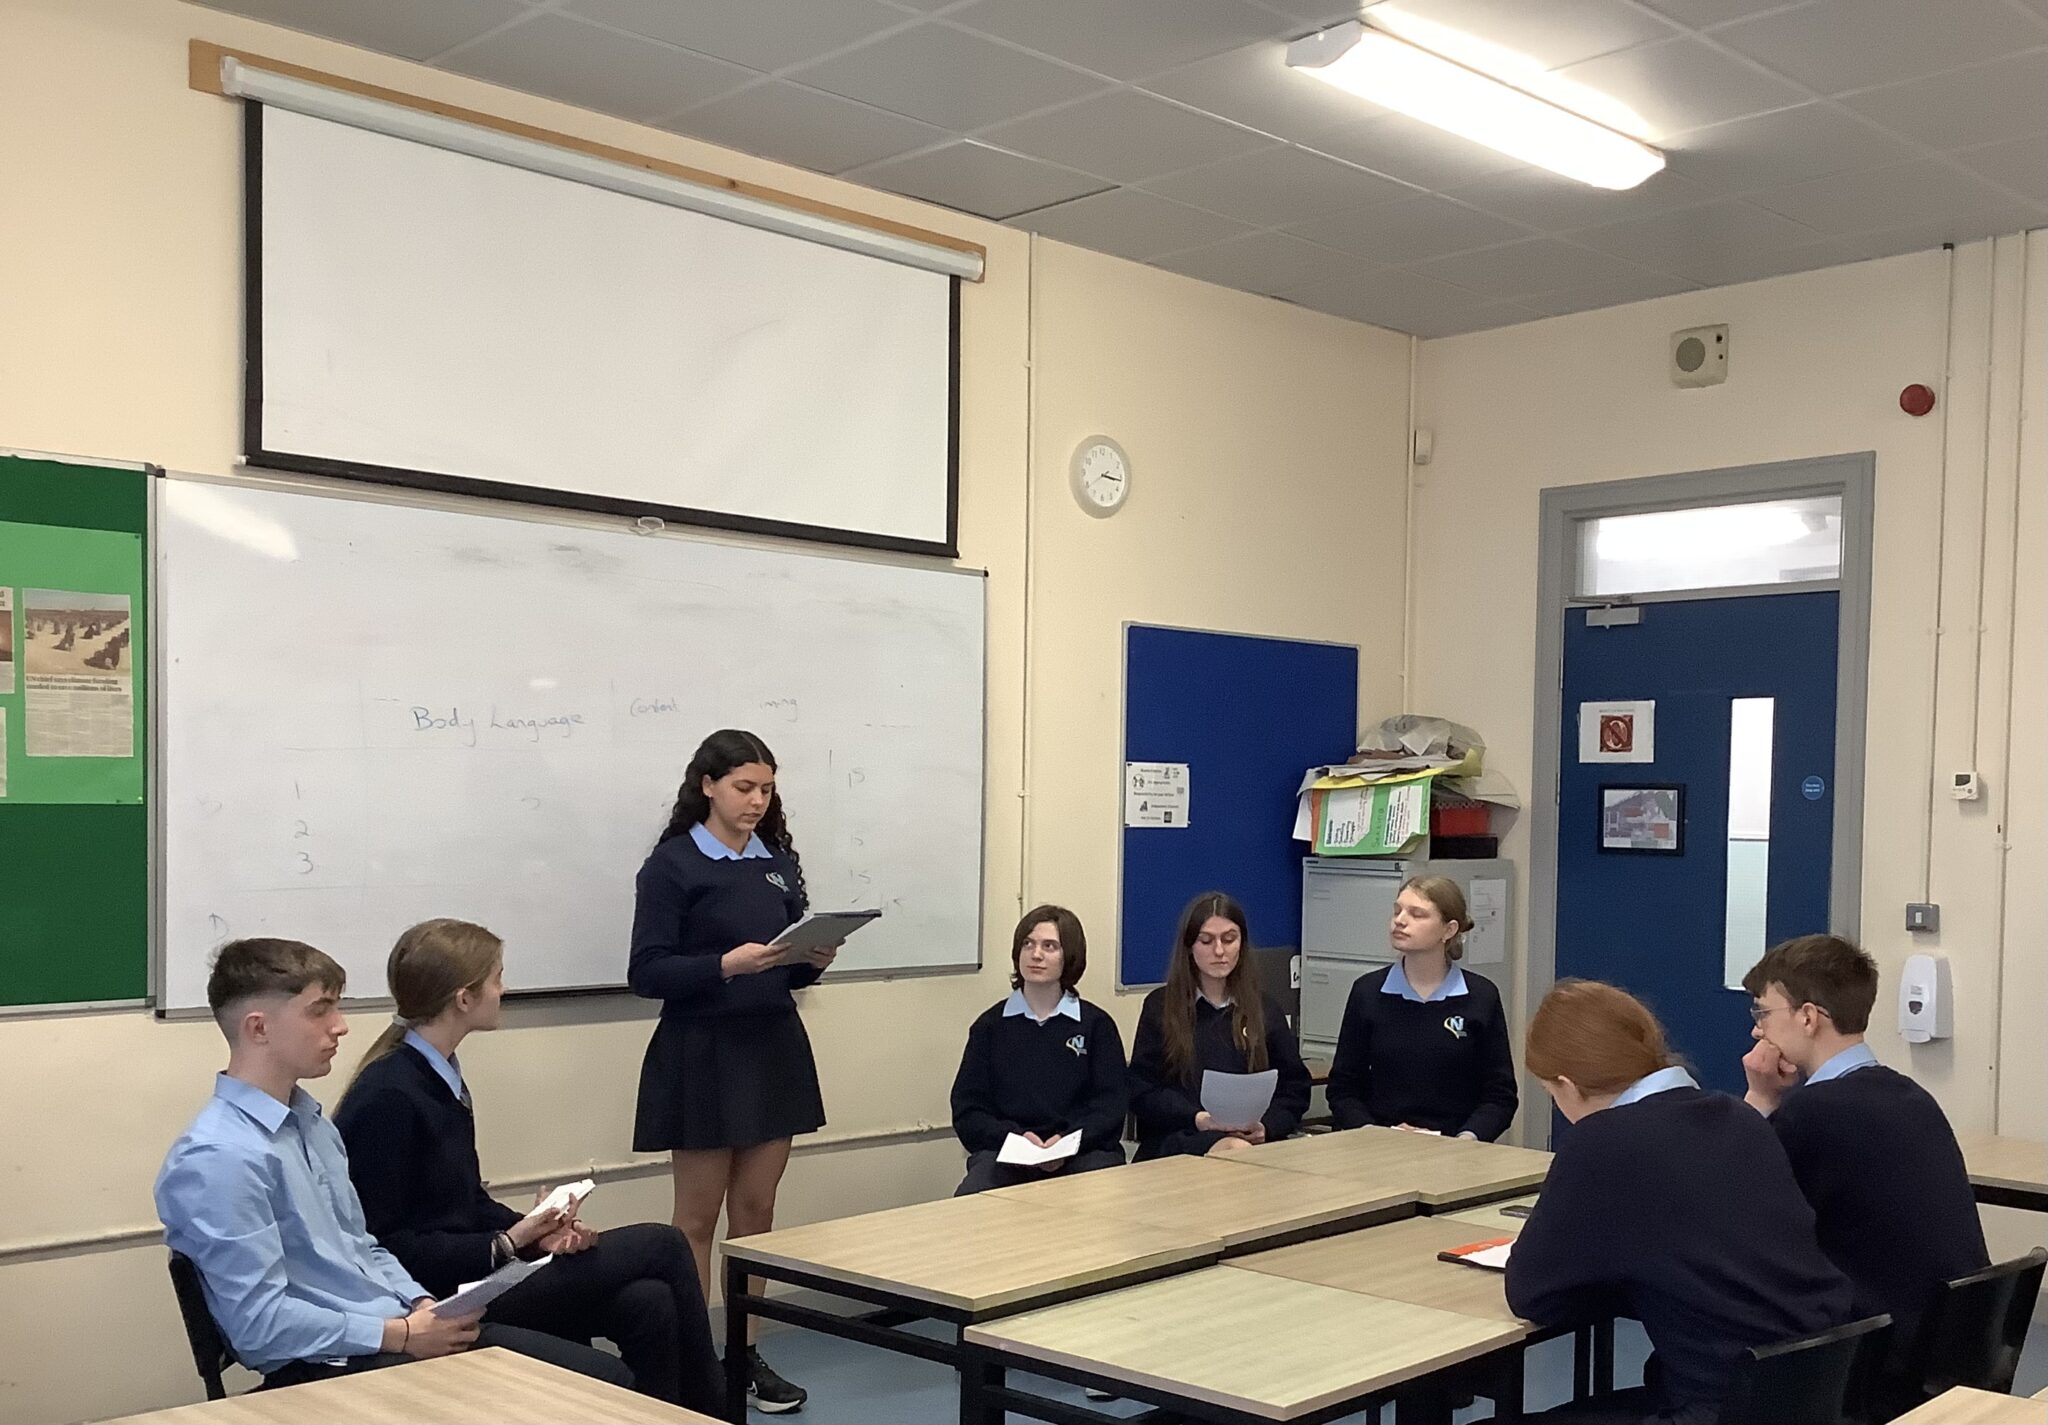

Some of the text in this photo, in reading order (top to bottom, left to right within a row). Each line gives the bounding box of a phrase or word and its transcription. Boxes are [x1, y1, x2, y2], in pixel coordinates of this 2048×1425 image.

[409, 704, 586, 748] Body Language
[294, 819, 310, 839] 2
[298, 851, 314, 875] 3
